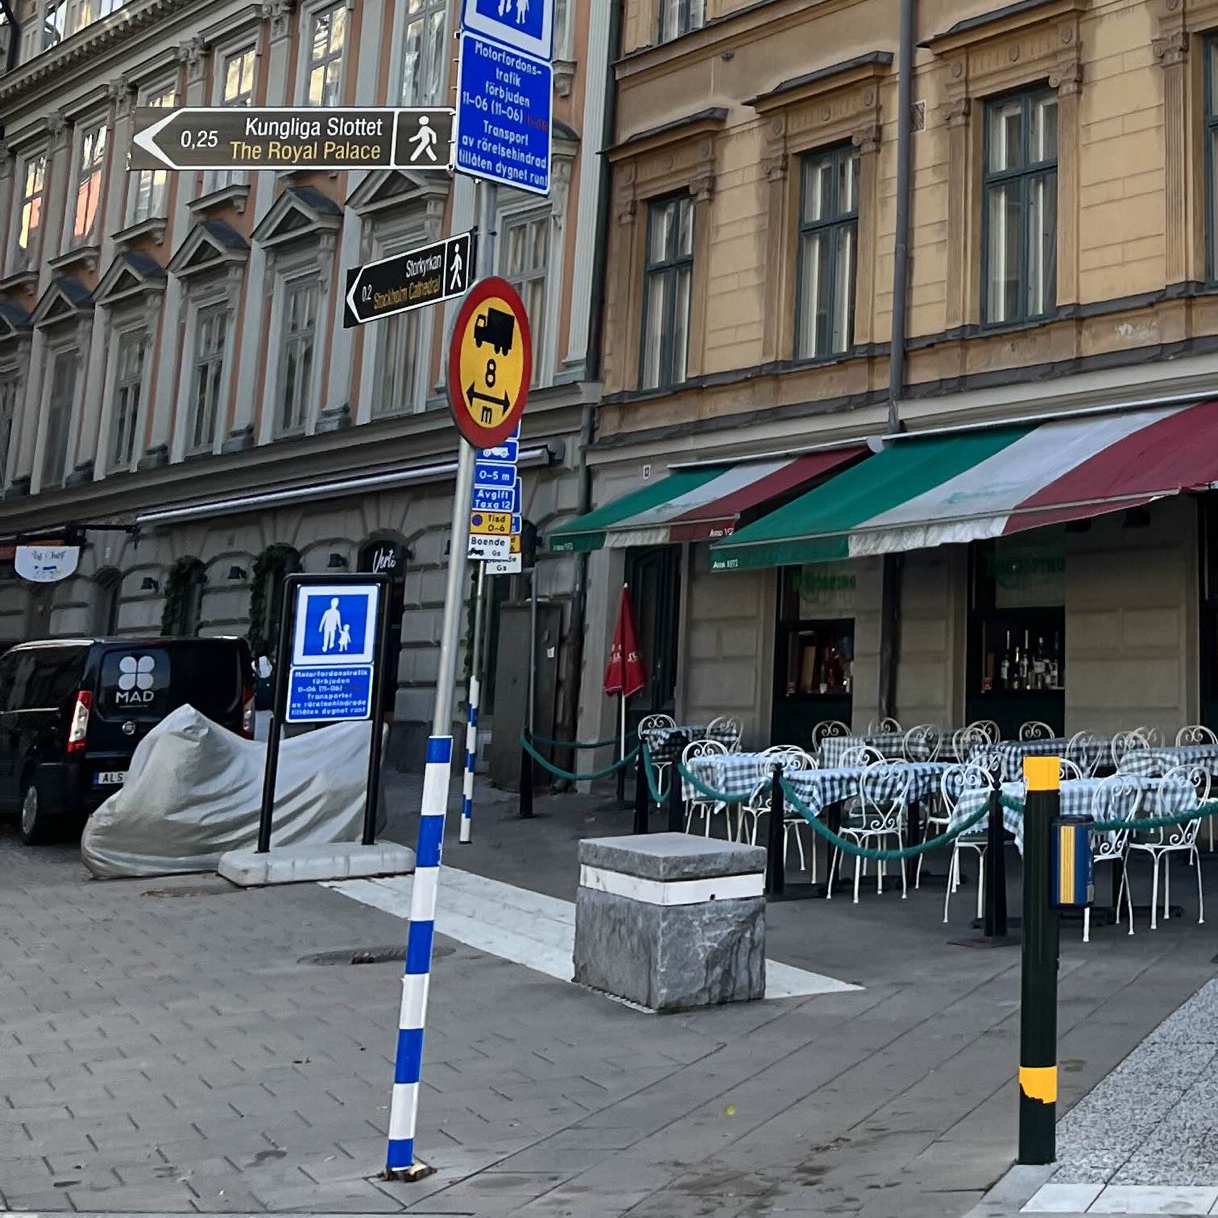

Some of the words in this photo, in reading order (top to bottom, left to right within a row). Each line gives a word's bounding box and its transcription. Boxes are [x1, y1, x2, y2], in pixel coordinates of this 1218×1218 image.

[474, 41, 542, 75] Motorfordons-
[496, 67, 522, 87] trafik
[485, 81, 530, 108] förbjuden
[462, 90, 488, 111] 11-06
[491, 99, 523, 124] (11-06)
[180, 130, 219, 149] 0,25
[245, 117, 321, 139] Kungliga
[326, 117, 383, 136] Slottet
[462, 135, 475, 147] av
[483, 120, 529, 146] Transport
[230, 141, 262, 160] The
[268, 141, 318, 163] Royal
[323, 141, 381, 160] Palace
[459, 148, 493, 170] tillåten
[495, 161, 528, 180] dygnet
[406, 254, 442, 278] Storkyrkan
[373, 287, 408, 310] Stockholm
[408, 274, 441, 300] Cathedral
[485, 358, 497, 388] 8
[481, 406, 493, 425] m
[479, 470, 499, 481] 0-5
[501, 473, 510, 481] m
[475, 499, 500, 509] Taxa
[501, 501, 511, 509] 12
[477, 489, 509, 501] Avgift
[487, 523, 505, 532] 0-6
[488, 515, 506, 523] Tisd
[471, 537, 506, 546] Boende
[115, 690, 154, 703] MAD
[102, 772, 124, 782] ALS
